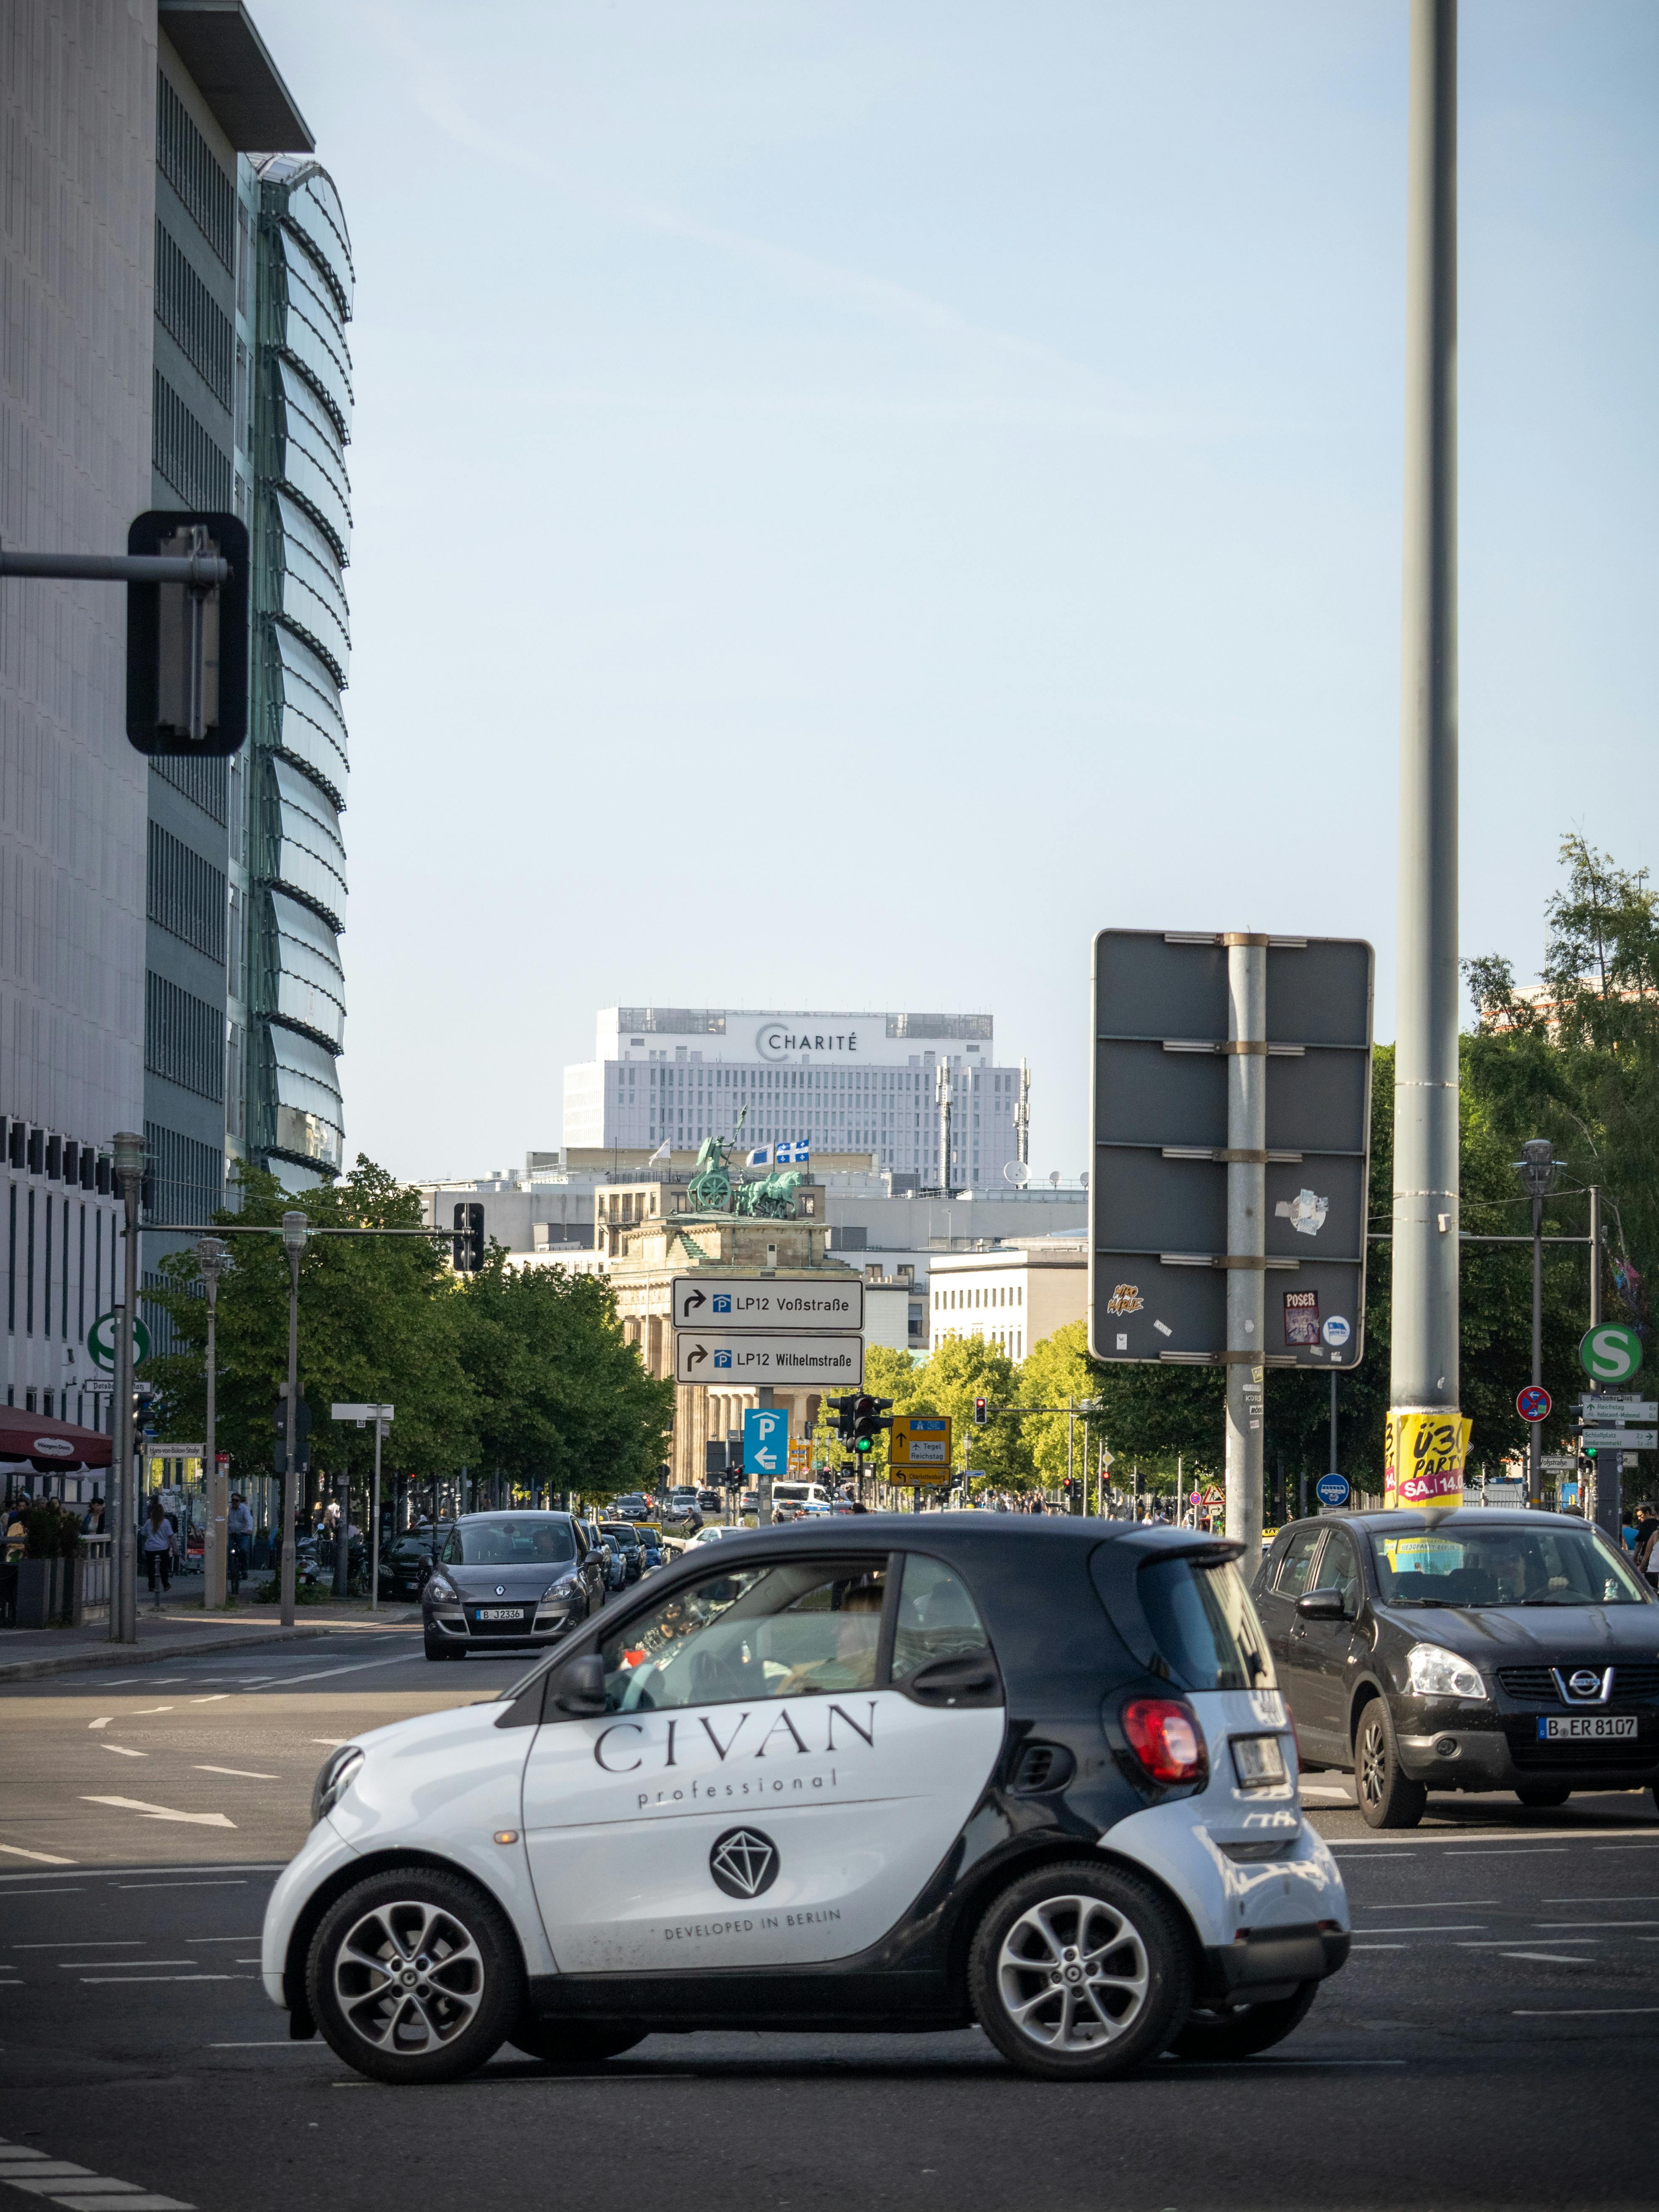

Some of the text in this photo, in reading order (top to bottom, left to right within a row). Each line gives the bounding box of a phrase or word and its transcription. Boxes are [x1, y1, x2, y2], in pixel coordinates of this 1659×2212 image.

[769, 1032, 856, 1050] CHARITÉ
[737, 1298, 769, 1310] LP12
[777, 1298, 849, 1311] Voßstraße
[1286, 1293, 1316, 1307] POSER
[737, 1353, 769, 1366] LP12
[776, 1353, 851, 1367] Wilhelmstraße
[1592, 1329, 1630, 1377] S
[759, 1419, 775, 1440] P
[1404, 1479, 1434, 1497] SA.
[594, 1700, 880, 1773] CIVAN
[1549, 1720, 1558, 1736] B
[1571, 1720, 1591, 1735] ER
[1596, 1719, 1635, 1735] 8107
[638, 1768, 837, 1810] professional
[665, 1908, 840, 1940] DEVELOPED IN BERLIN
